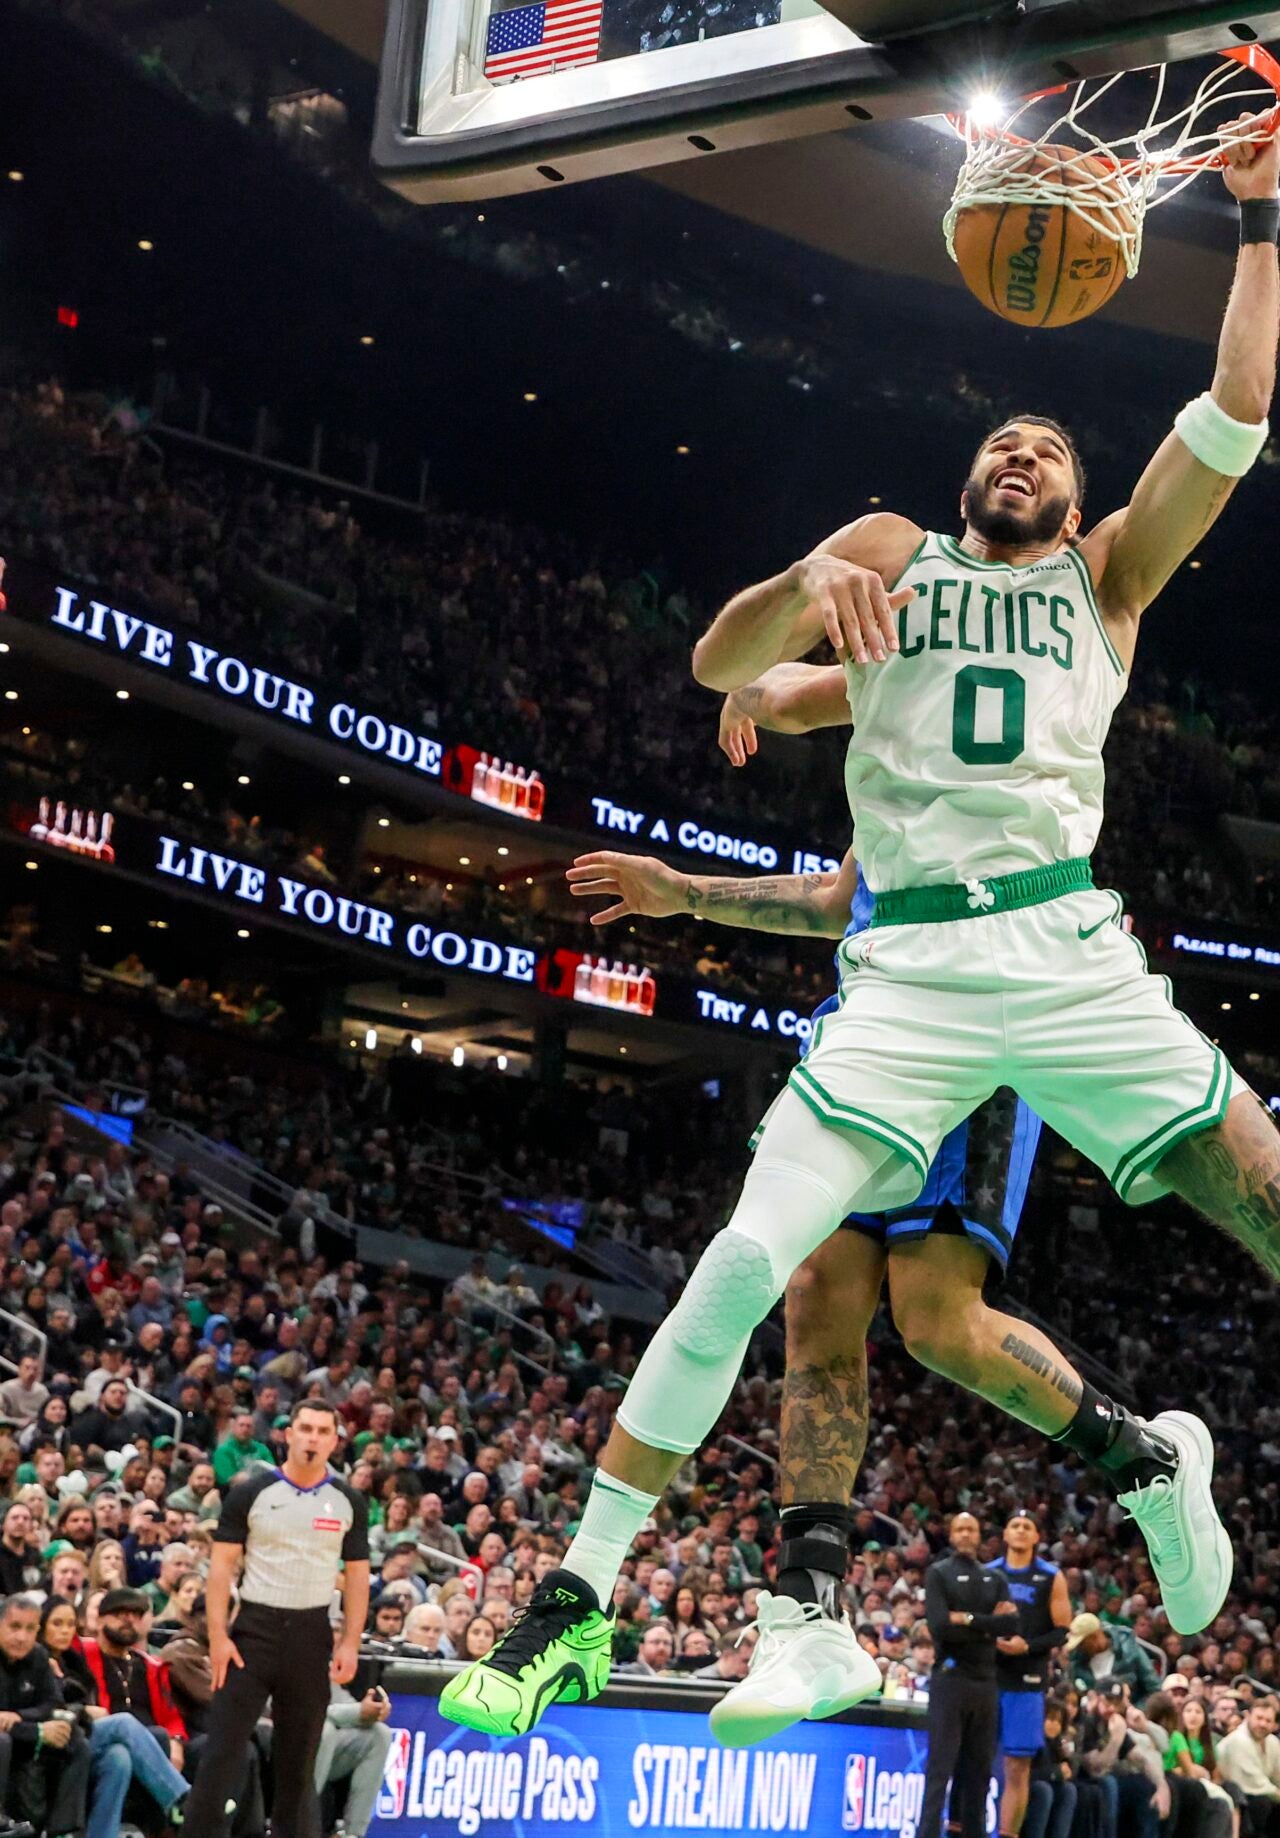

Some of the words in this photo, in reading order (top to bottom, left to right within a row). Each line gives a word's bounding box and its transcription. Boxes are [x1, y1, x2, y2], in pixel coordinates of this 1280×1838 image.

[1006, 204, 1050, 312] Wilson
[898, 579, 1075, 670] CELTICS
[51, 586, 174, 667] LIVE
[187, 640, 315, 724] YOUR
[329, 703, 443, 775] CODE
[952, 664, 1026, 766] 0
[592, 797, 645, 834] TRY
[650, 820, 670, 842] A
[678, 822, 778, 869] CODIGO
[156, 836, 266, 903] LIVE
[278, 876, 395, 947] YOUR
[406, 923, 535, 983] CODE
[1173, 934, 1225, 956] PLEASE
[1227, 943, 1252, 959] SIP
[697, 990, 746, 1024] TRY
[751, 1008, 770, 1030] A
[406, 1731, 523, 1835] League
[522, 1737, 599, 1822] Pass
[628, 1742, 748, 1829] STREAM
[749, 1750, 818, 1832] NOW
